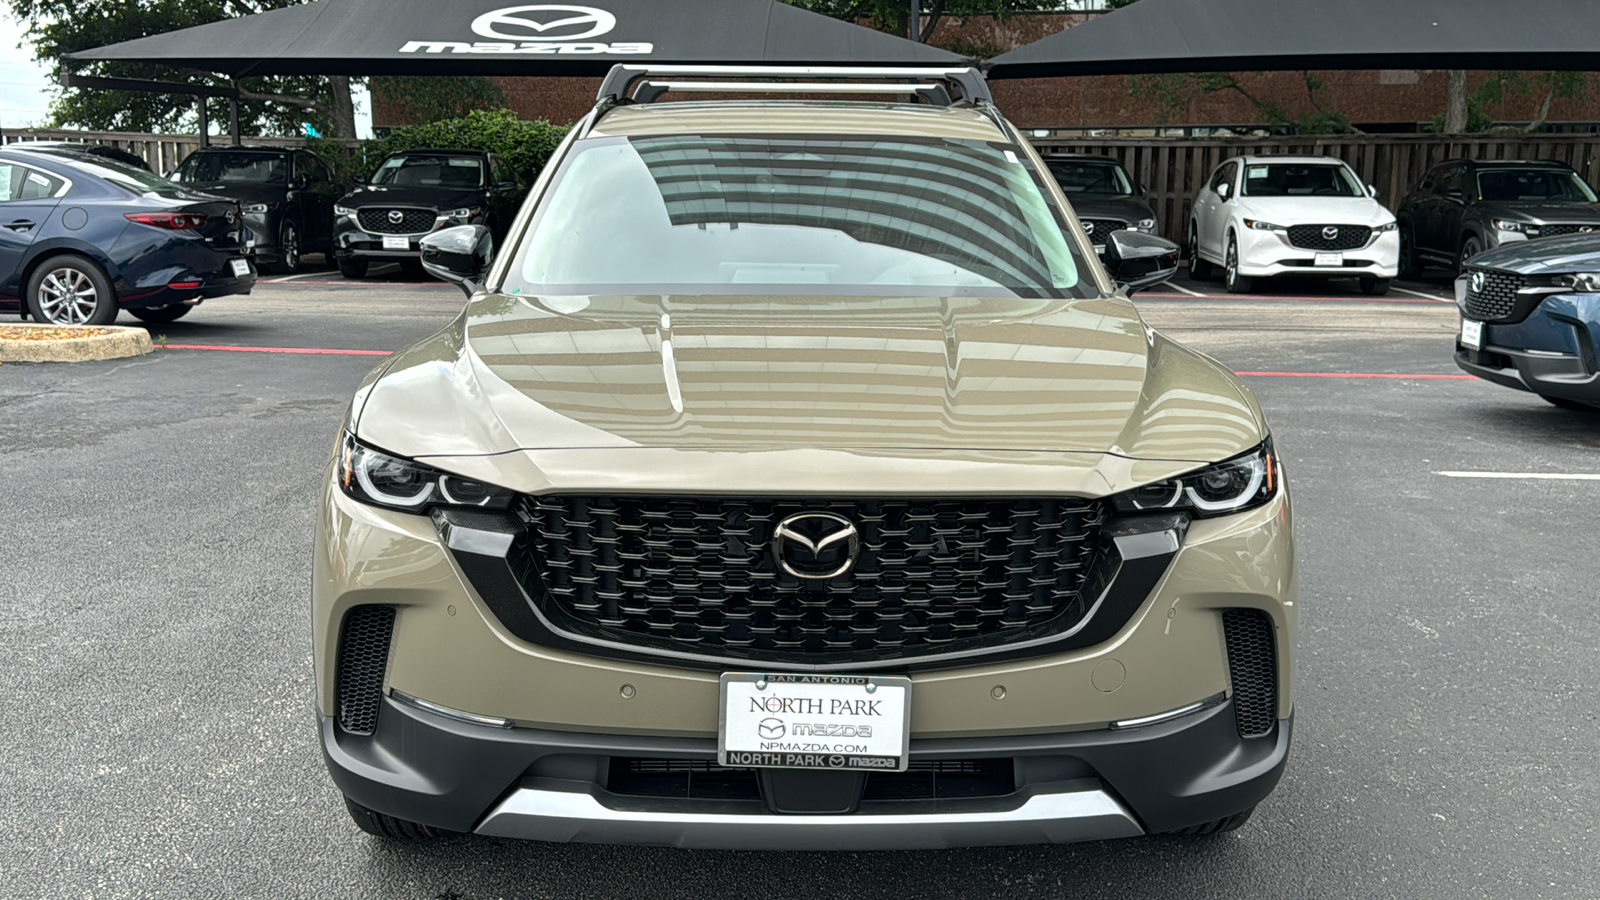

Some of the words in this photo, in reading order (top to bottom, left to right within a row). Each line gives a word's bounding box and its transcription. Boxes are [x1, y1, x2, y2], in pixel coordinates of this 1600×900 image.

[398, 41, 654, 54] mazda
[767, 675, 796, 683] SAN
[801, 675, 866, 684] ANTONIO
[749, 696, 824, 715] NORTH
[830, 698, 883, 716] PARK
[792, 723, 873, 738] mazda
[760, 742, 868, 753] NPMAZDA.COM
[730, 752, 782, 765] NORTH
[786, 753, 825, 766] PARK
[849, 757, 896, 768] mazda
